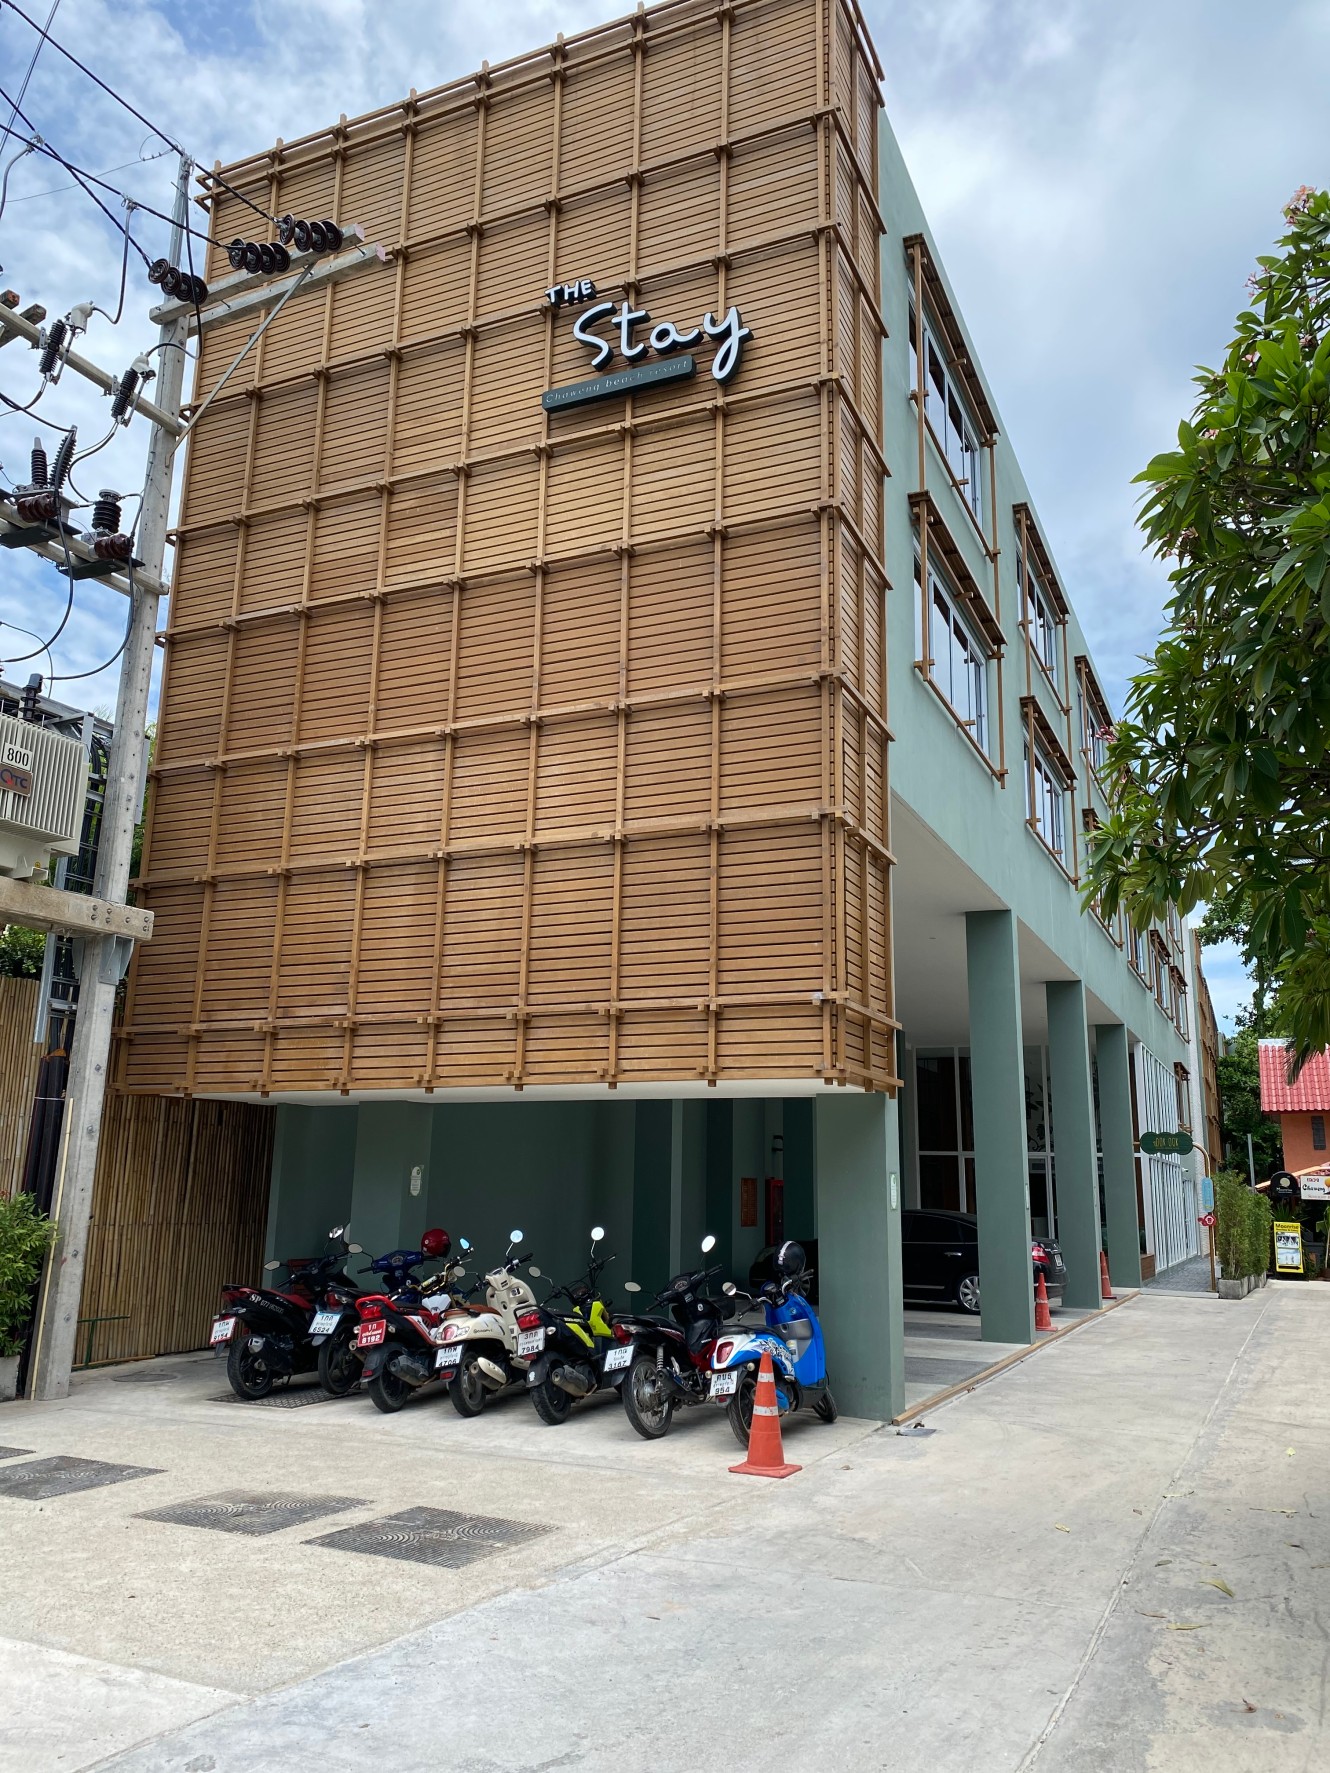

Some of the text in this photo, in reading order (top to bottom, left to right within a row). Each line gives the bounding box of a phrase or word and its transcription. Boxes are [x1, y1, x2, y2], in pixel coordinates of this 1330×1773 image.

[545, 279, 597, 304] THE
[573, 301, 754, 385] Stay
[546, 360, 688, 403] Chaweng beach resort
[6, 747, 29, 767] 800
[1302, 1183, 1325, 1193] Chaweng
[249, 1293, 262, 1303] SP
[362, 1335, 381, 1344] 8192
[521, 1345, 540, 1353] 7984
[608, 1360, 628, 1369] 3167
